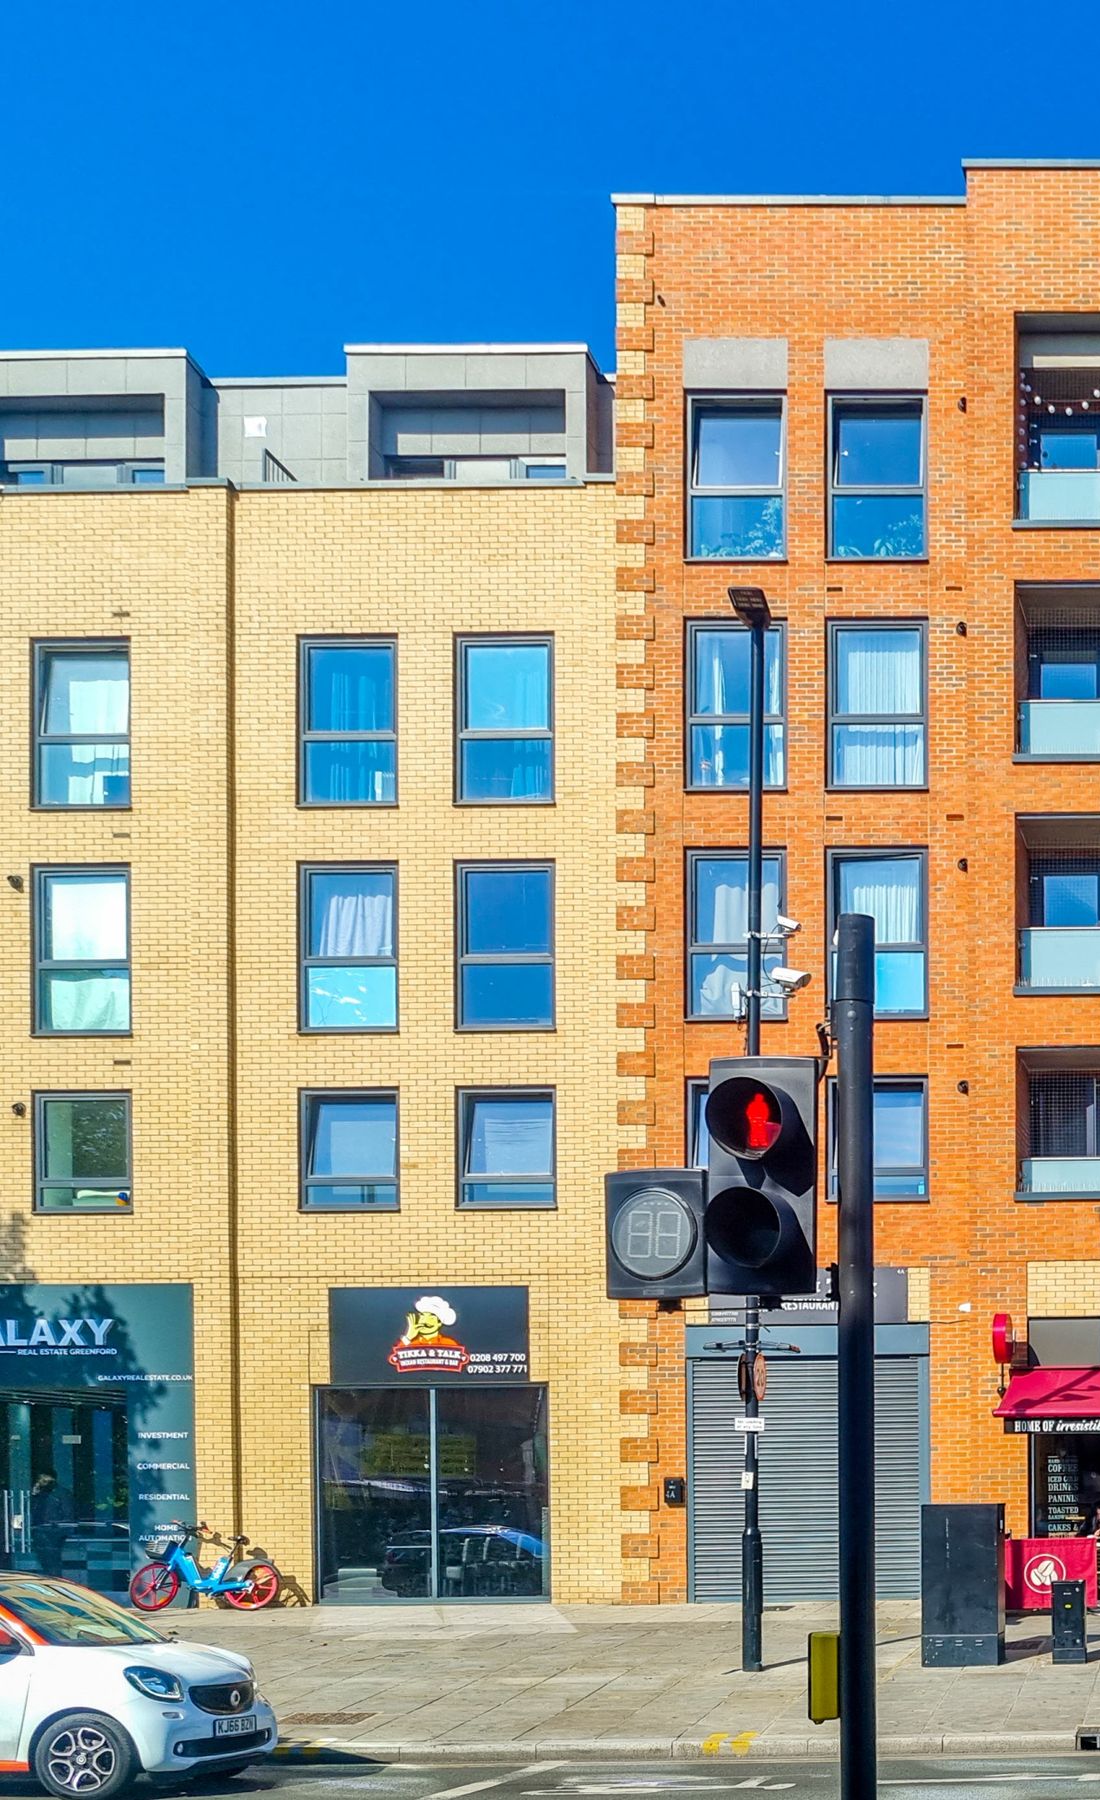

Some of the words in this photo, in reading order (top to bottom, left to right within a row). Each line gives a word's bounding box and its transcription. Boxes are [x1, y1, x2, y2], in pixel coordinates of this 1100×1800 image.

[0, 1318, 114, 1347] LAXY
[17, 1348, 38, 1356] REAL
[40, 1348, 68, 1356] ESTATE
[69, 1347, 118, 1356] GREENFORD
[397, 1349, 427, 1359] TIKKA
[428, 1349, 436, 1357] &
[437, 1349, 461, 1359] TALK
[469, 1353, 491, 1362] 0208
[492, 1353, 508, 1362] 497
[510, 1353, 526, 1362] 700
[467, 1364, 493, 1374] 07902
[494, 1364, 511, 1374] 377
[512, 1364, 527, 1374] 771
[97, 1374, 193, 1382] GALAXYREALESTATE.CO.UK
[1014, 1420, 1041, 1432] HOME
[1042, 1420, 1055, 1432] OF
[137, 1431, 189, 1439] INVESTMENT
[136, 1462, 190, 1470] COMMERCIAL
[1047, 1463, 1079, 1473] COFFEE
[1047, 1482, 1079, 1492] DRINKS
[138, 1493, 190, 1501] RESIDENTIAL
[1047, 1494, 1079, 1503] PANINIS
[1047, 1506, 1079, 1514] TOASTED
[1047, 1523, 1071, 1531] CAKES
[217, 1720, 239, 1734] KJ66
